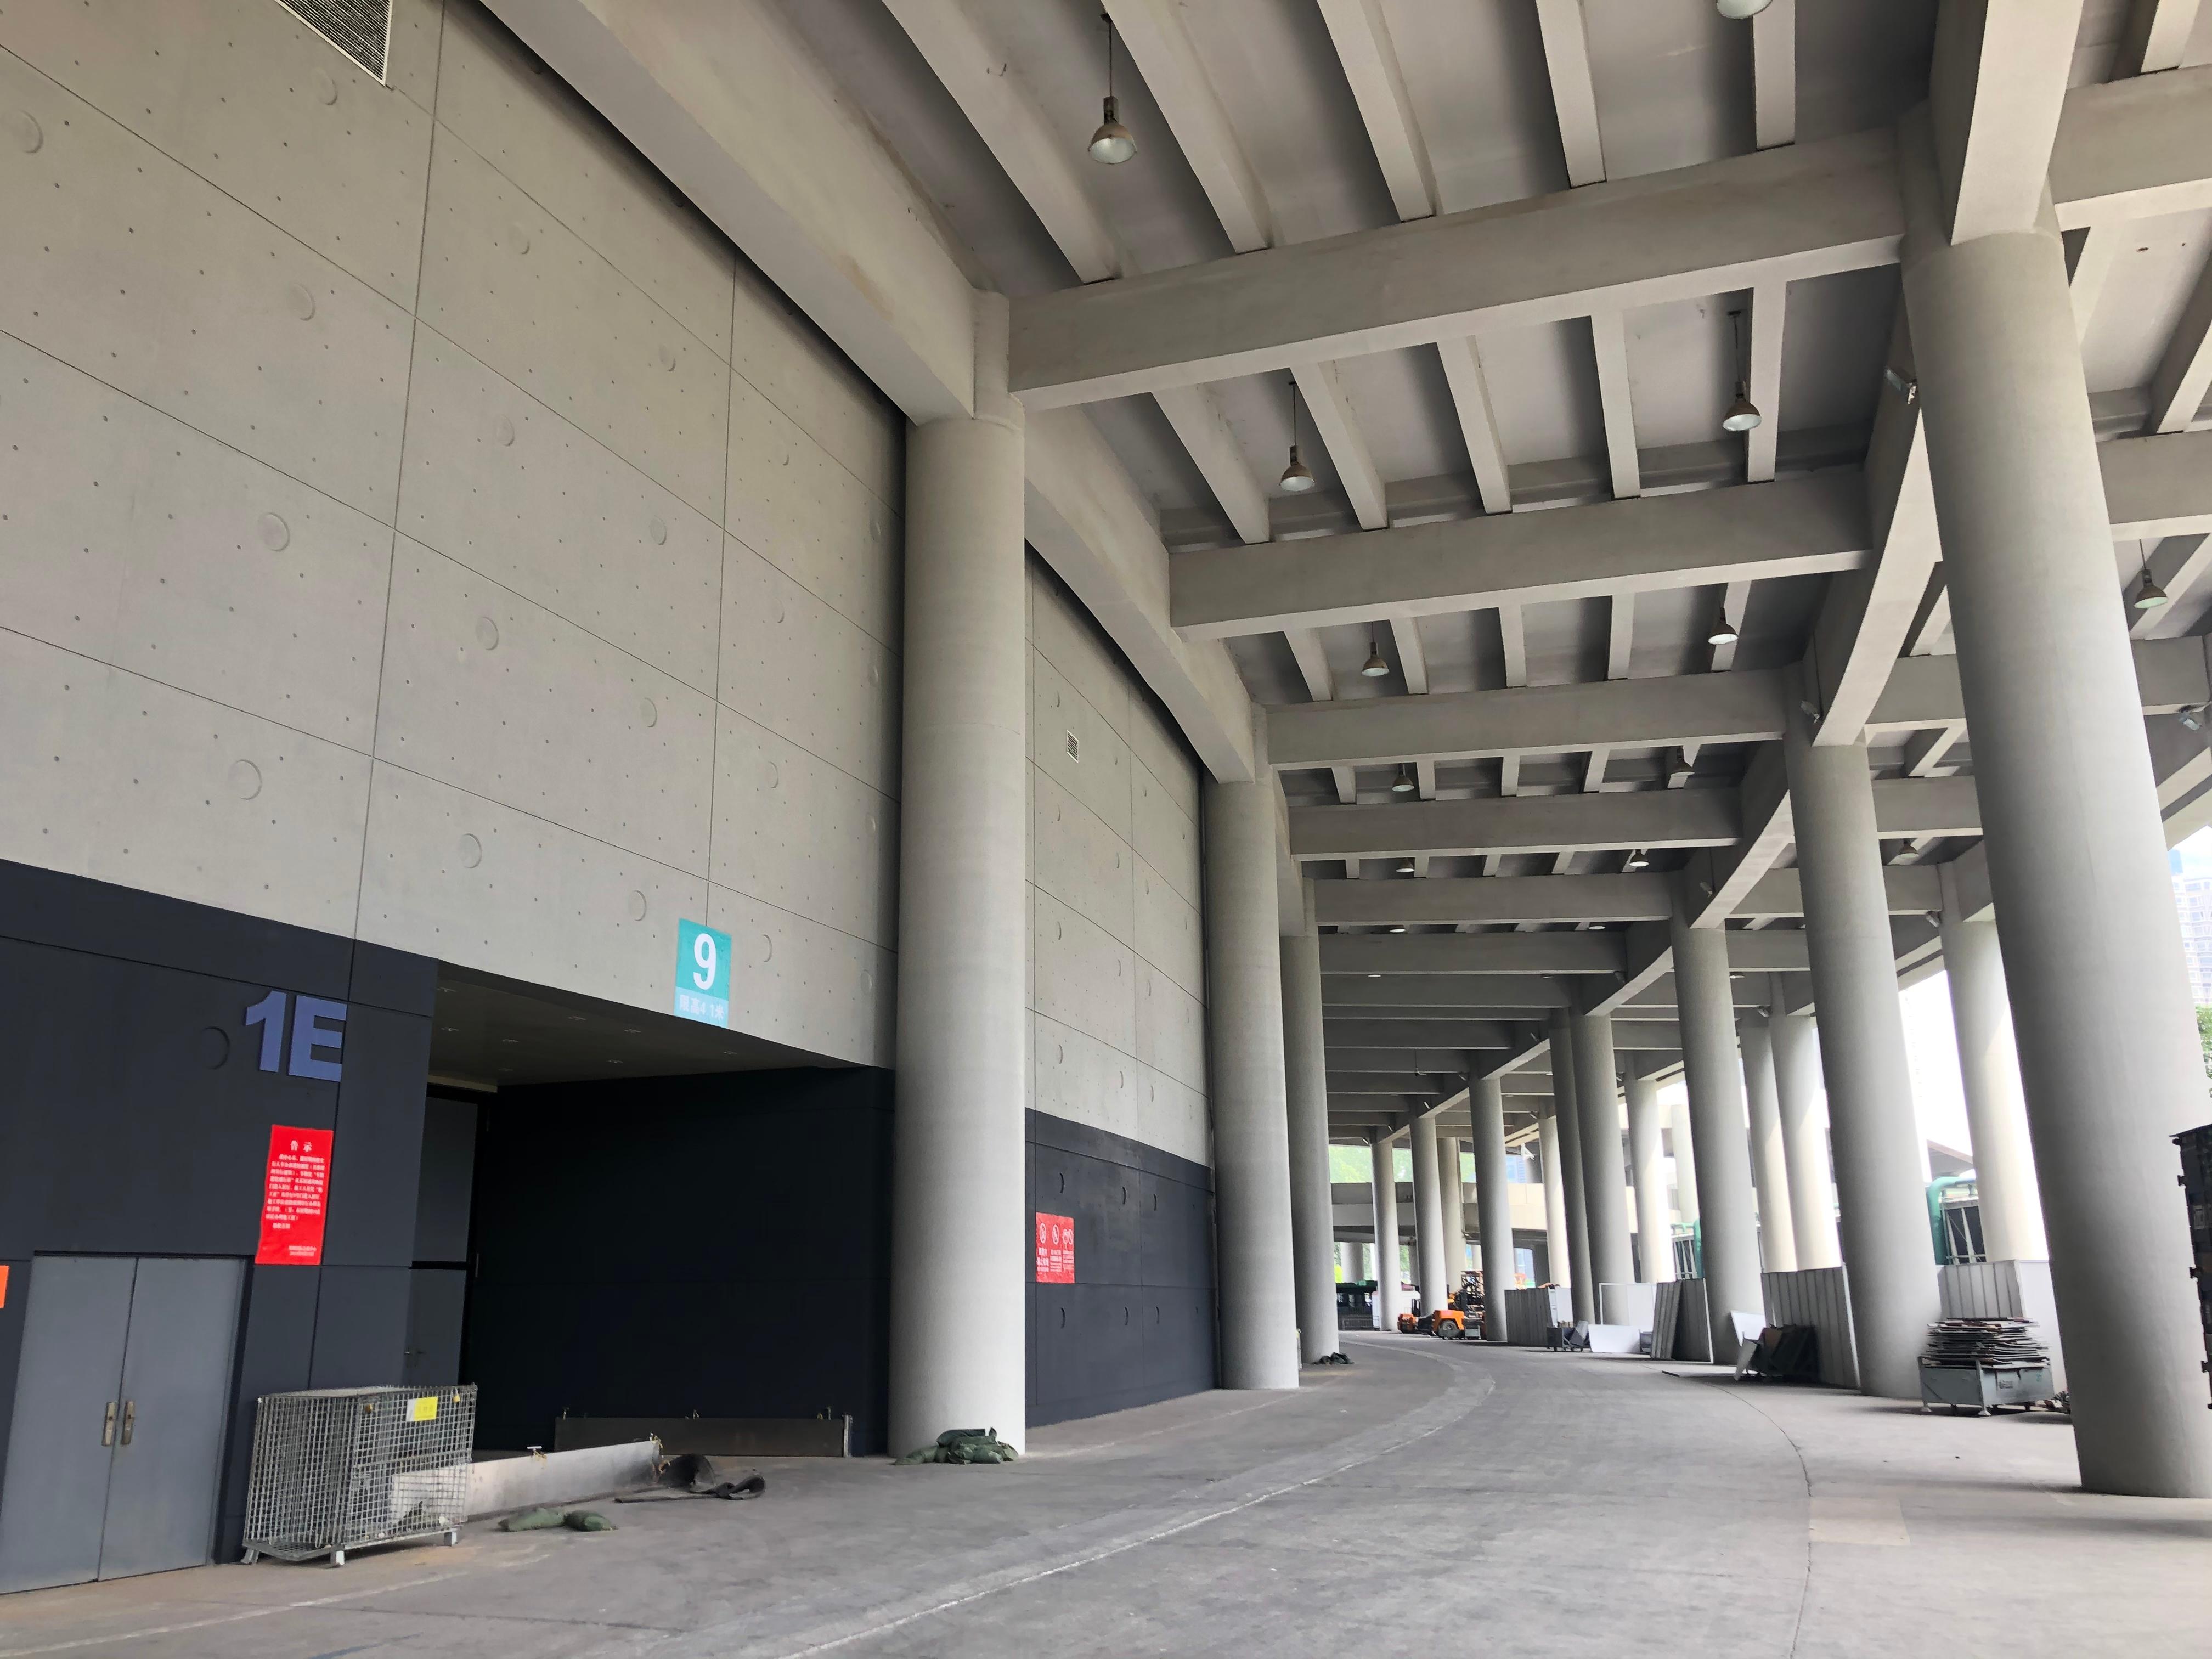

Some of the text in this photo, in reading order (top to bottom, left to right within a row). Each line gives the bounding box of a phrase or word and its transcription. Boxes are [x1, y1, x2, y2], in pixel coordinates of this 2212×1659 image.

[693, 933, 716, 990] 9
[246, 990, 347, 1082] 1E
[679, 994, 725, 1021] 限高41米
